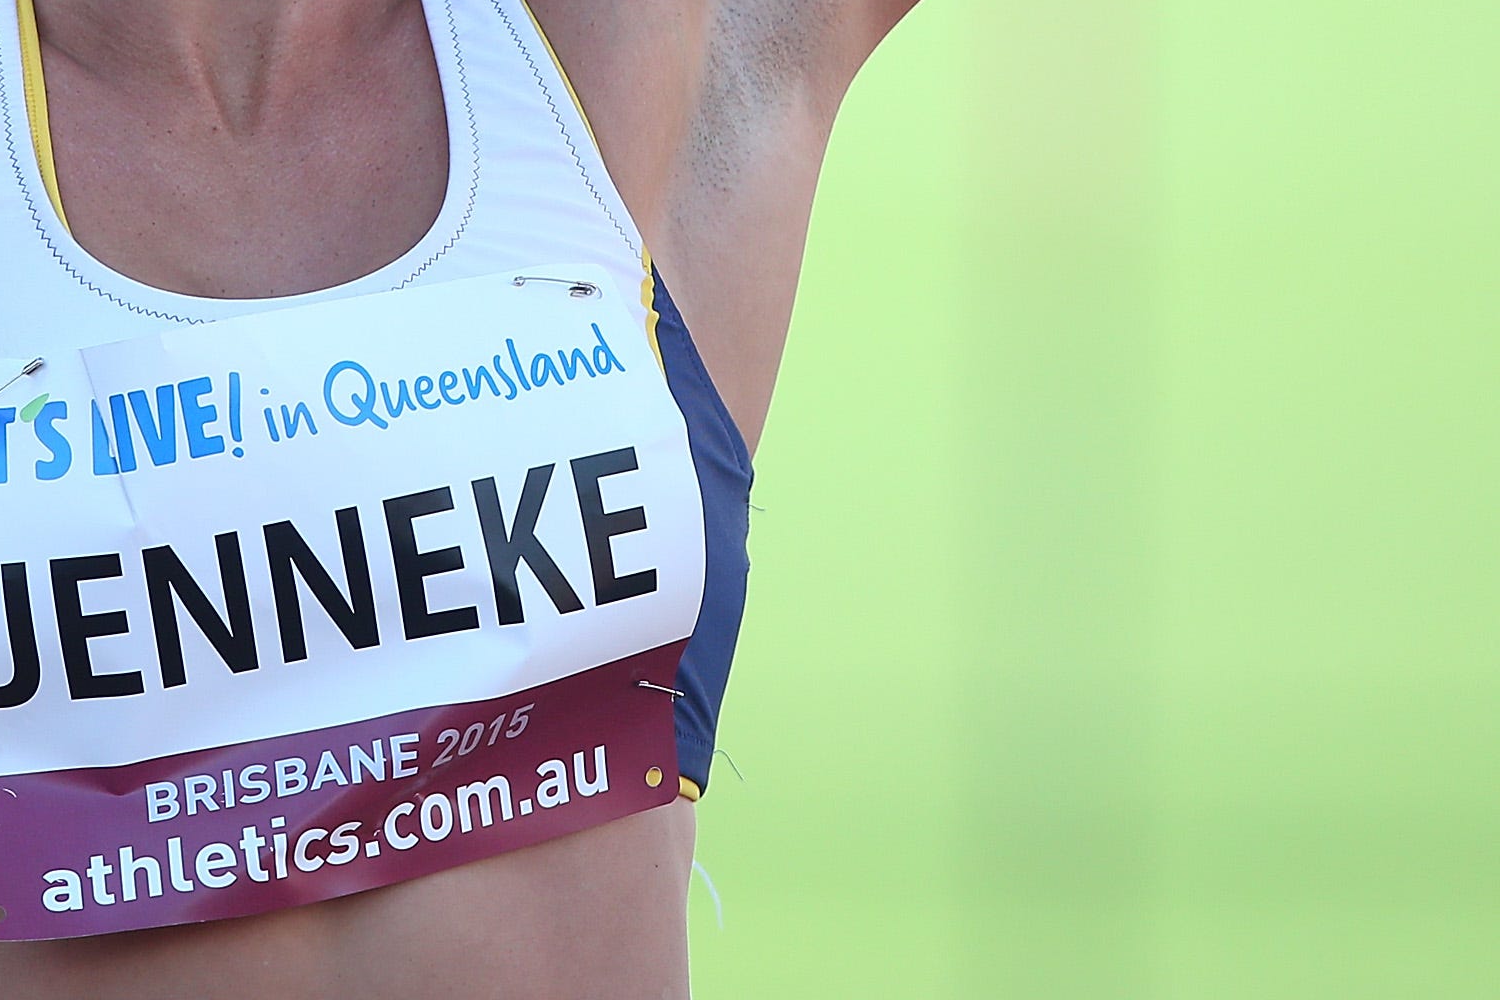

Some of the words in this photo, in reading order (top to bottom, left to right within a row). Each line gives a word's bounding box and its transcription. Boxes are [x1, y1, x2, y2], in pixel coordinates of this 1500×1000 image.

[92, 371, 244, 475] LIVE!
[260, 388, 317, 443] in
[323, 323, 623, 430] Queensland
[41, 744, 609, 912] athletics.com.au
[146, 732, 421, 824] BRISBANE
[432, 704, 534, 769] 2015
